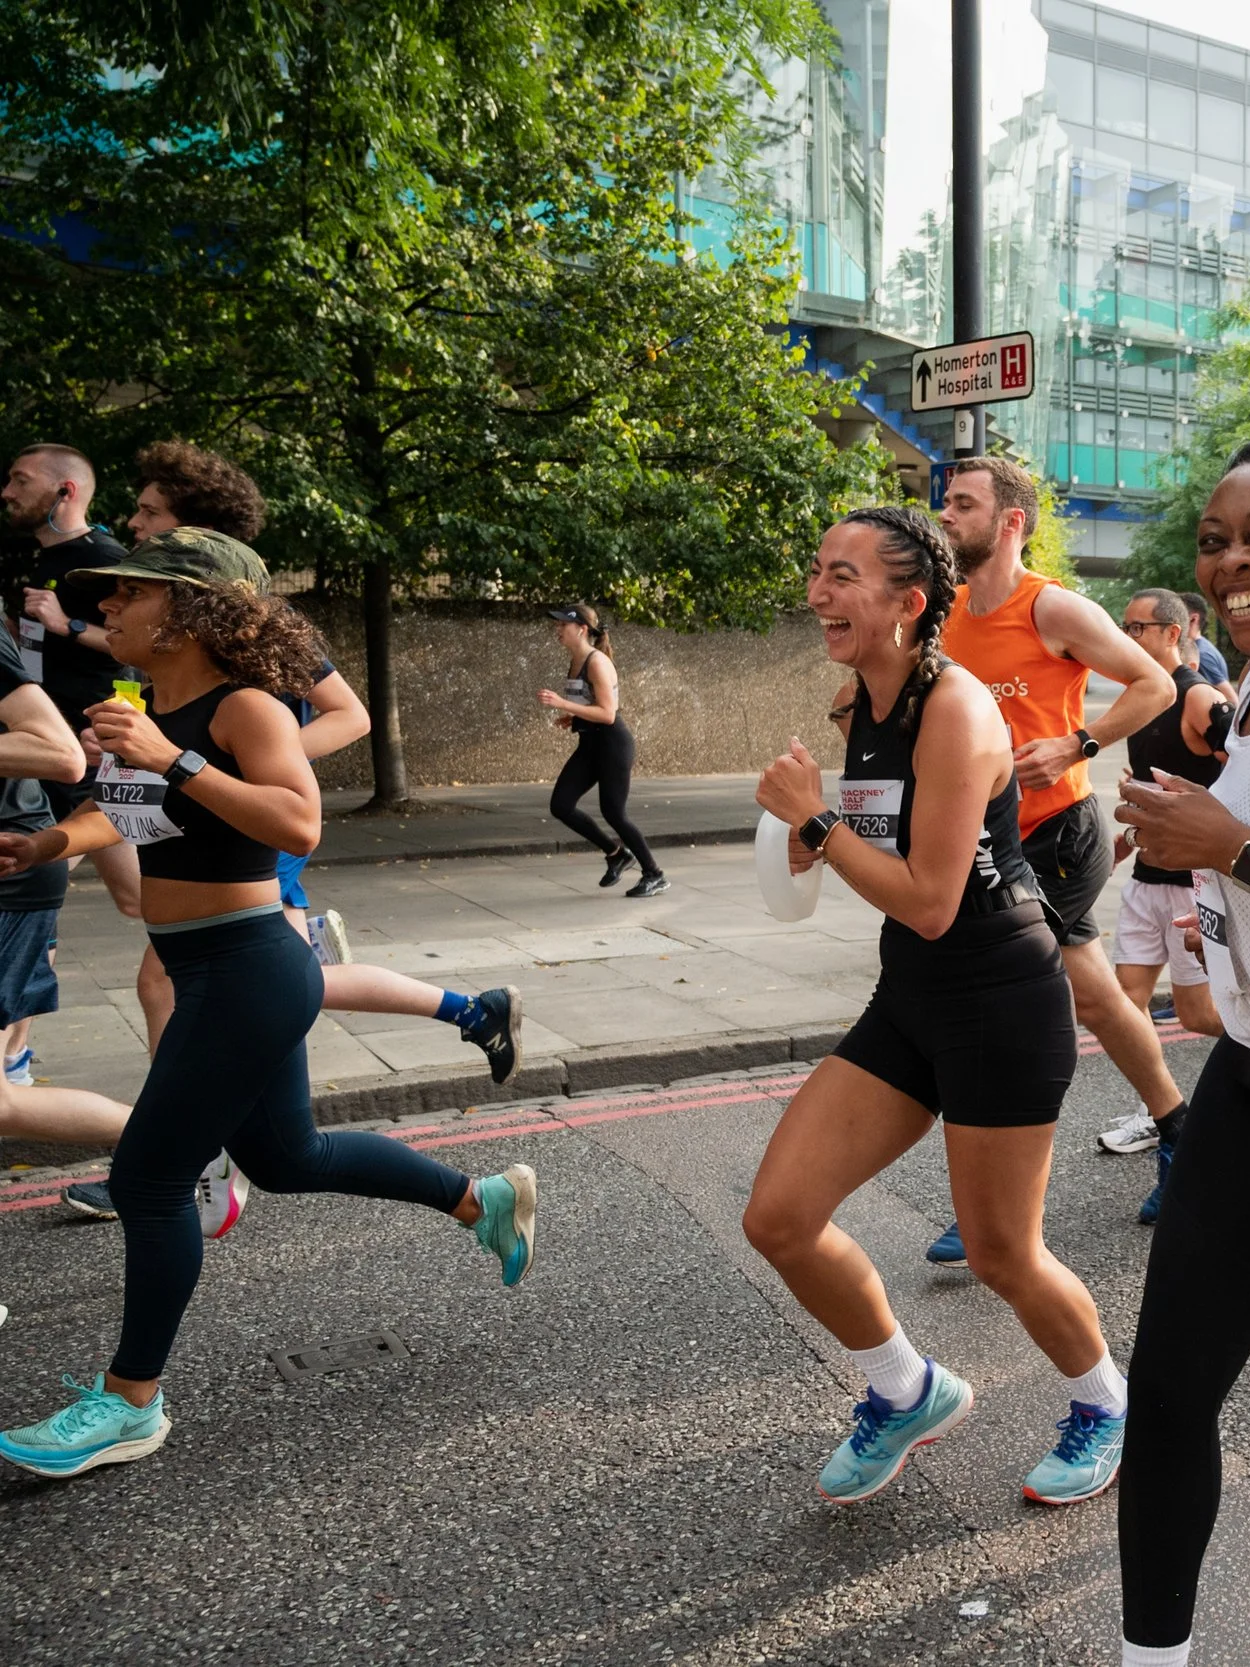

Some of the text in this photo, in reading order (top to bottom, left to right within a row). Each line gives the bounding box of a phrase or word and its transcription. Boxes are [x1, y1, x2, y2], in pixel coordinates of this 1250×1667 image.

[934, 350, 997, 374] Homerton
[1006, 347, 1021, 374] H
[938, 372, 993, 396] Hospital
[959, 420, 967, 432] 9
[102, 784, 145, 803] D 4722
[841, 789, 886, 797] HACKNEY
[842, 796, 866, 804] HALF
[842, 803, 864, 811] 2021
